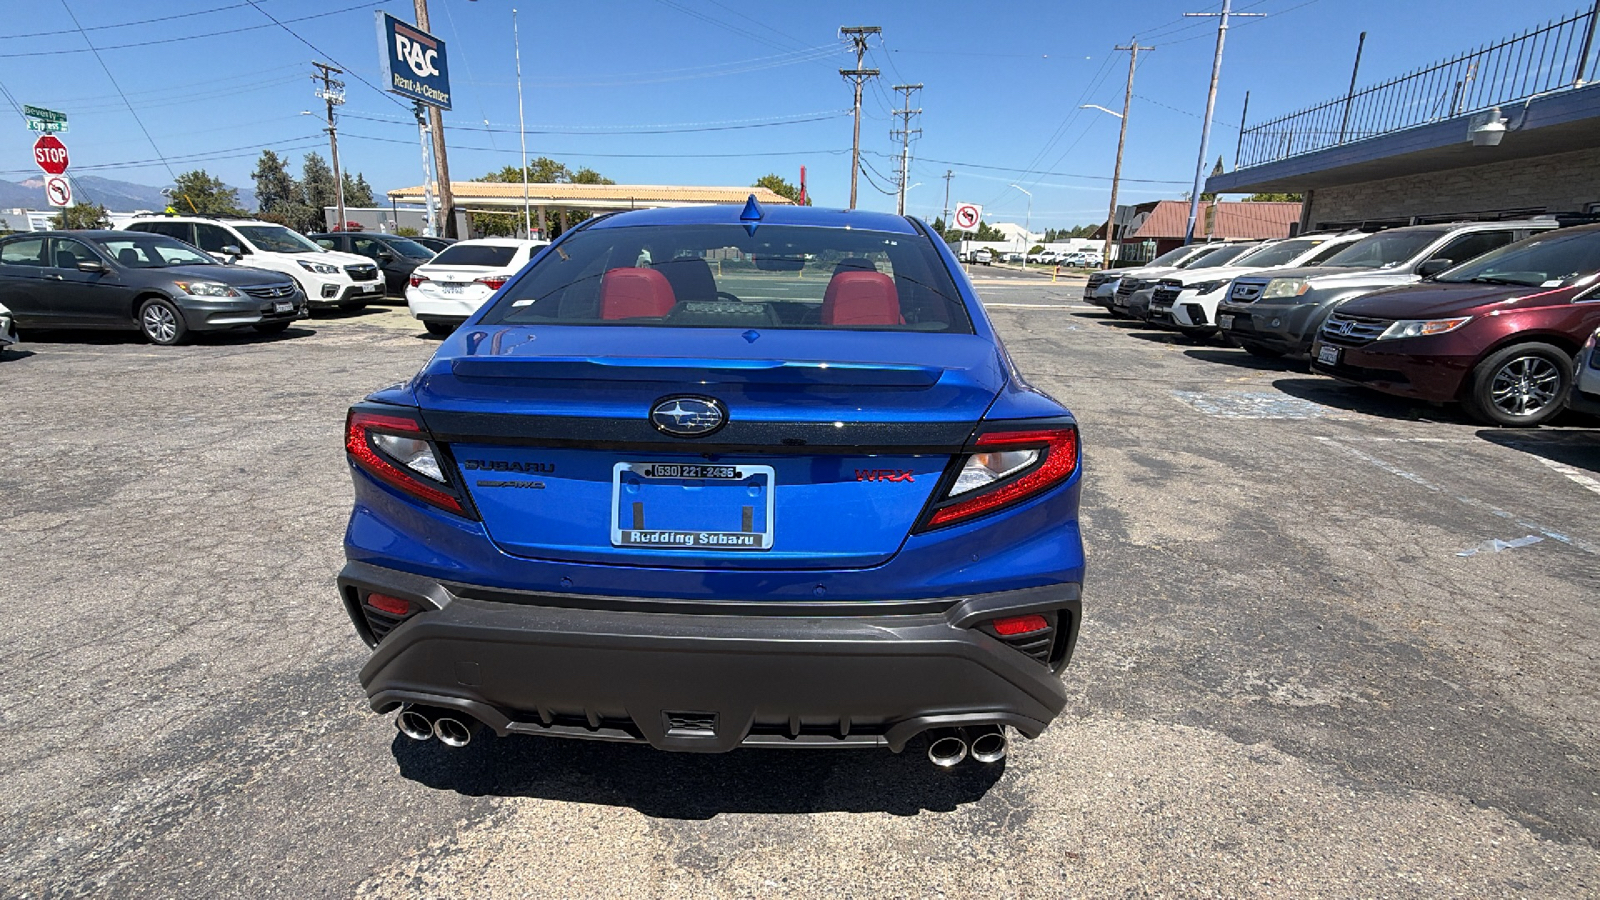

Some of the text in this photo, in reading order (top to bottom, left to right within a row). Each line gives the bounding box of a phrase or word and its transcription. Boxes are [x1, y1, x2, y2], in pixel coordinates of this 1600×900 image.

[395, 33, 439, 78] RAC
[36, 148, 66, 163] STOP
[464, 460, 555, 473] SUBARU
[854, 469, 916, 483] WRX
[630, 532, 754, 546] Redding Subaru
